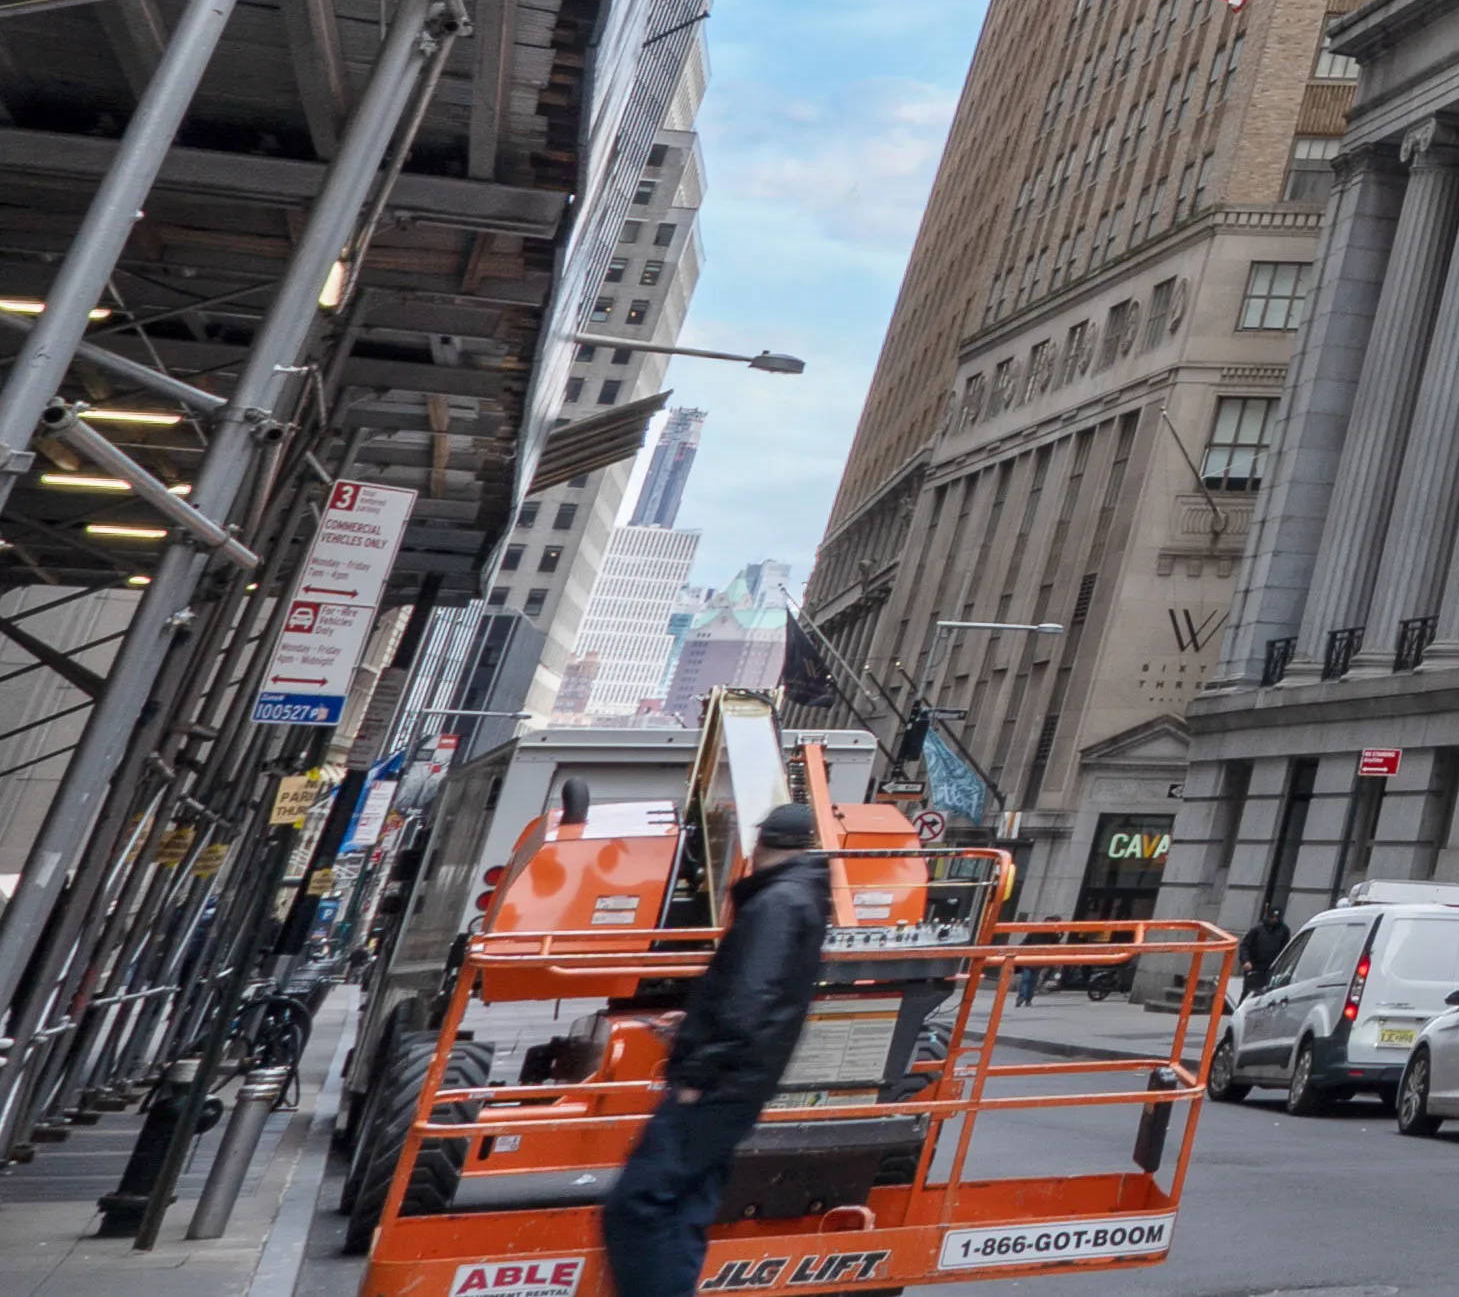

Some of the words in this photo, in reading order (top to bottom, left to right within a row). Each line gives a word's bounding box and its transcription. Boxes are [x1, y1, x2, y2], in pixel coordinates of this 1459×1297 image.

[335, 485, 354, 508] 3
[325, 518, 381, 536] COMMERCIAL
[320, 532, 363, 547] VEHICLES
[363, 537, 389, 550] ONLY
[314, 626, 334, 637] Only
[319, 616, 354, 627] Vehicles
[1168, 609, 1231, 653] W
[256, 703, 312, 721] 100527
[1108, 833, 1171, 859] CAVA
[960, 1224, 1165, 1258] 1-866-GOT-BOOM
[455, 1261, 579, 1295] ABLE
[699, 1257, 791, 1290] JLG
[787, 1250, 891, 1285] LIFT
[525, 1288, 570, 1297] RENTAL
